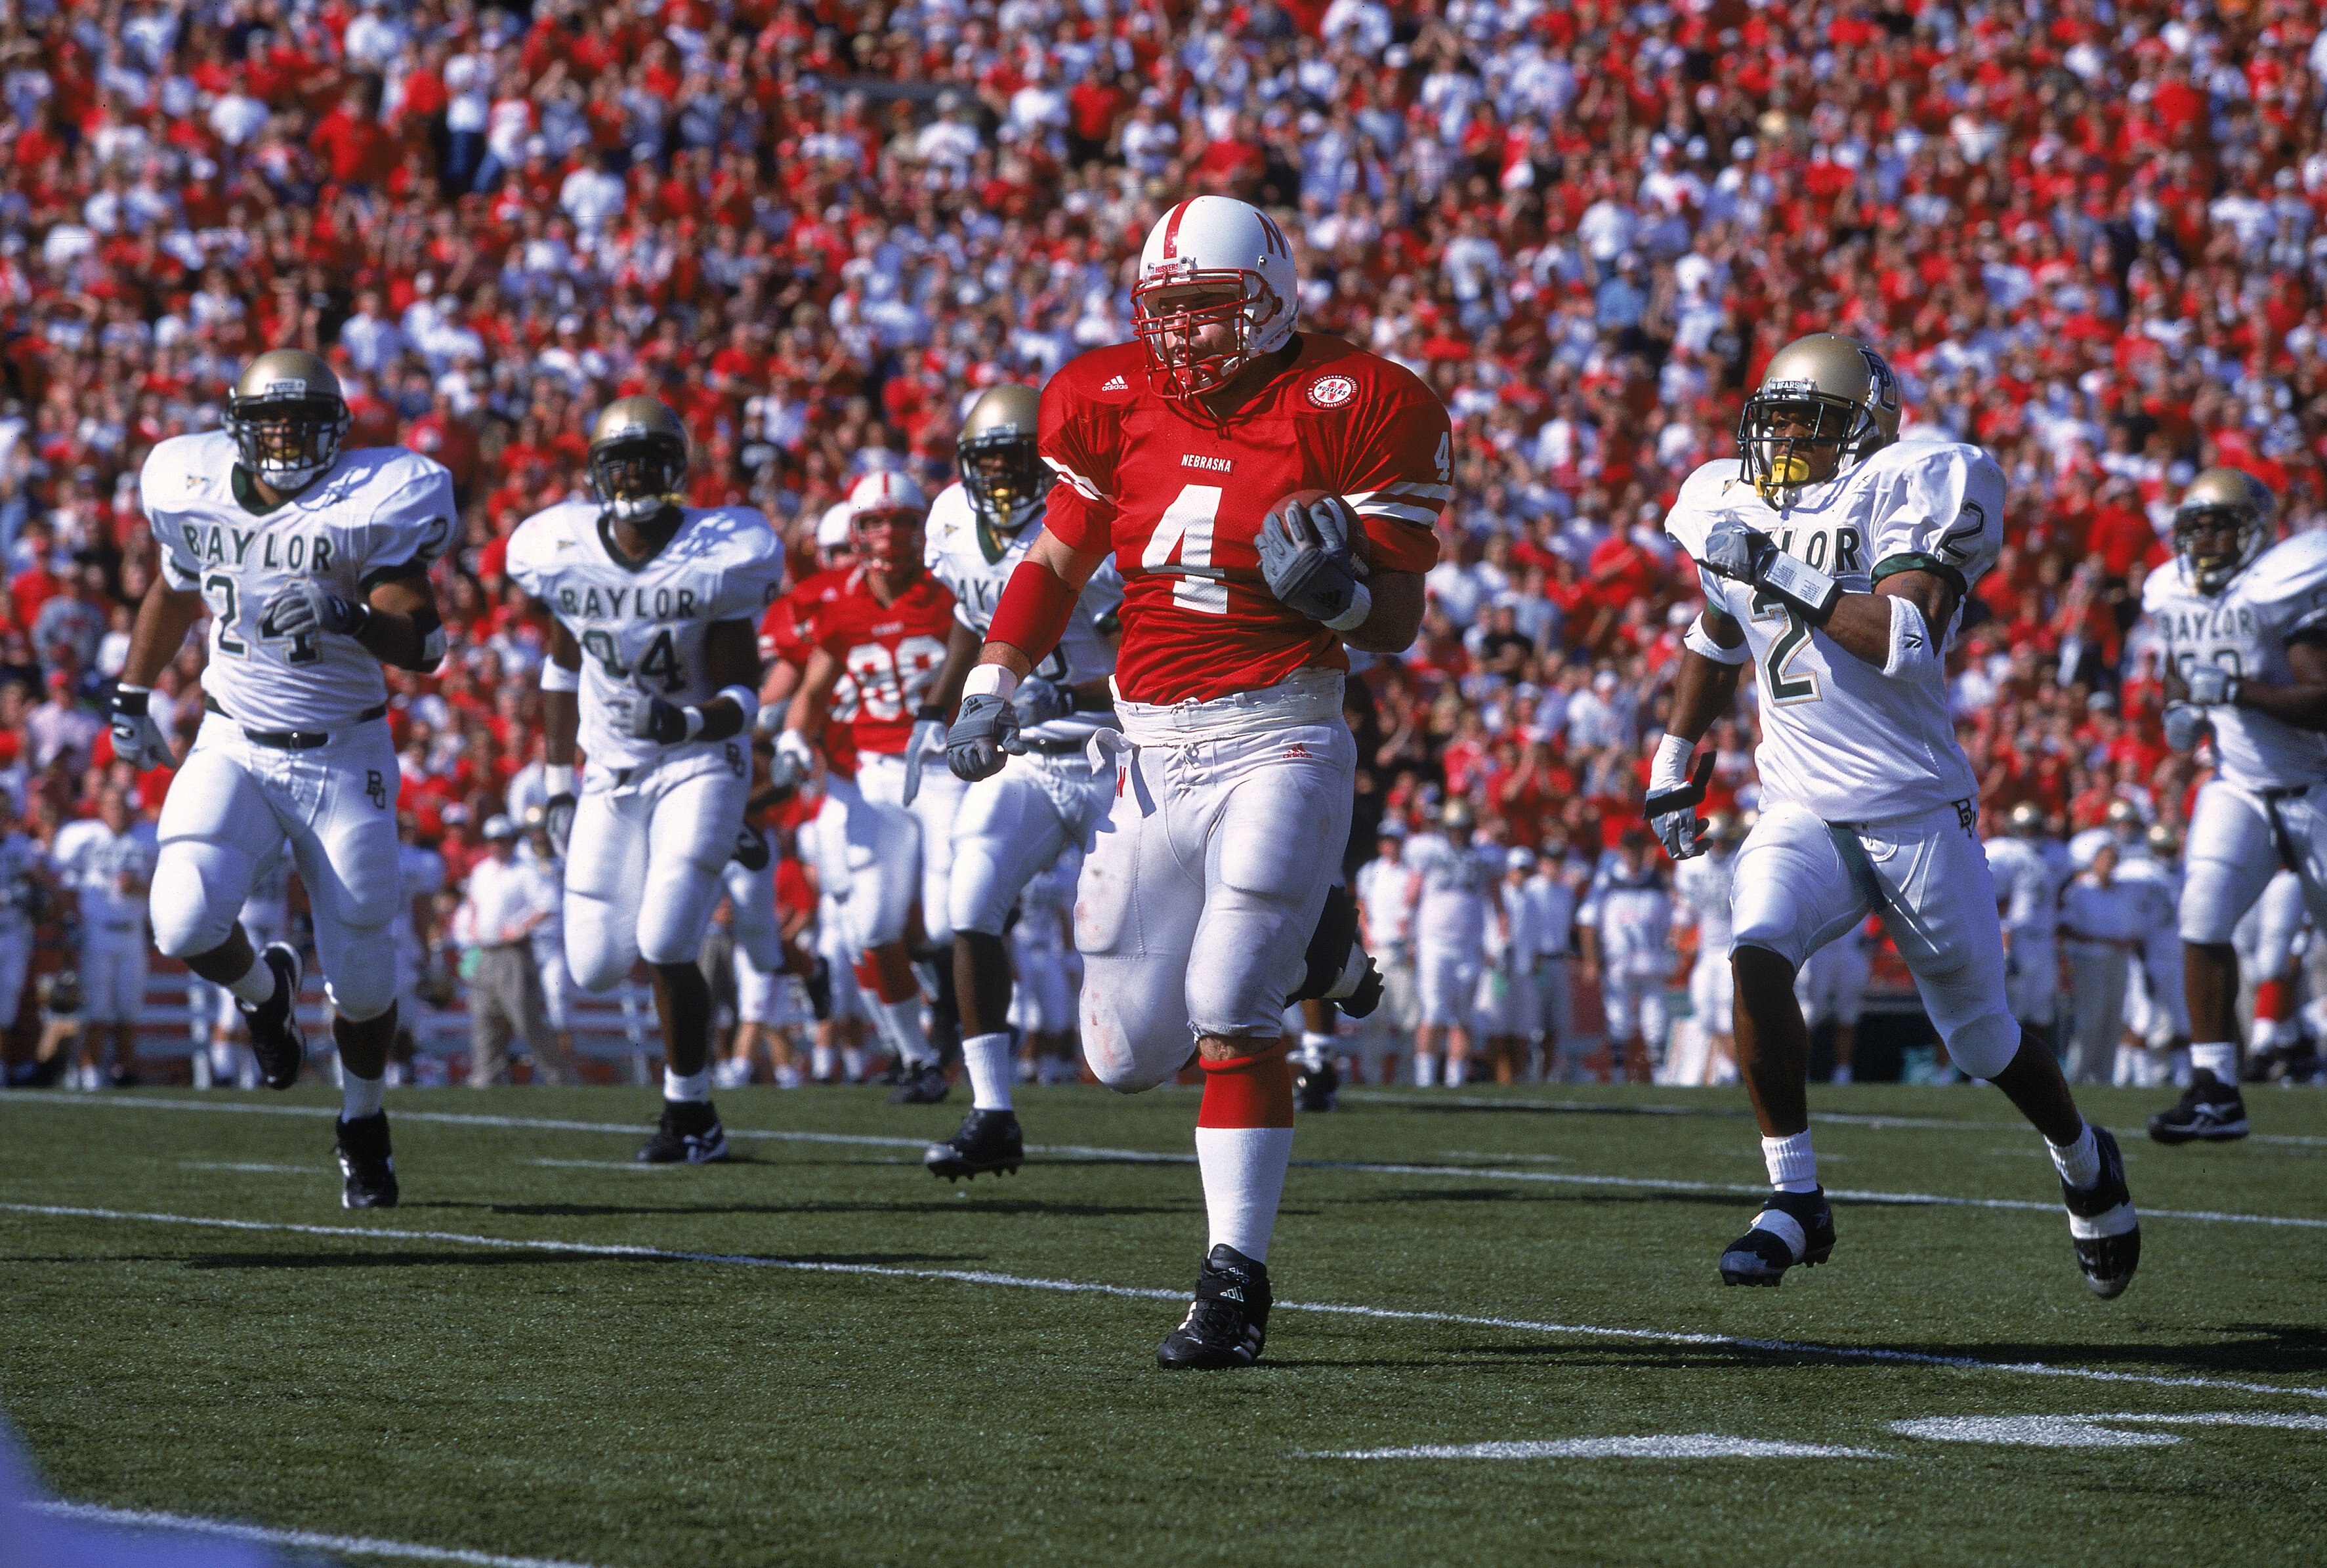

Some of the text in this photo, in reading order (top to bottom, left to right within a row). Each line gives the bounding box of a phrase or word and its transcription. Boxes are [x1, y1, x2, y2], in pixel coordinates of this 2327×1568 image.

[1254, 212, 1287, 260] N
[1155, 263, 1179, 274] HUSKERS
[1317, 385, 1347, 396] HUSKERS
[1776, 381, 1801, 390] BEARS
[1181, 453, 1232, 472] NEBRASKA
[1434, 431, 1450, 482] 4
[181, 523, 335, 575] BAYLOR
[1141, 484, 1228, 615] 4
[1935, 499, 1986, 563] 2
[559, 587, 696, 619] BAYLOR
[1746, 589, 1823, 707] 2
[366, 770, 387, 809] BU
